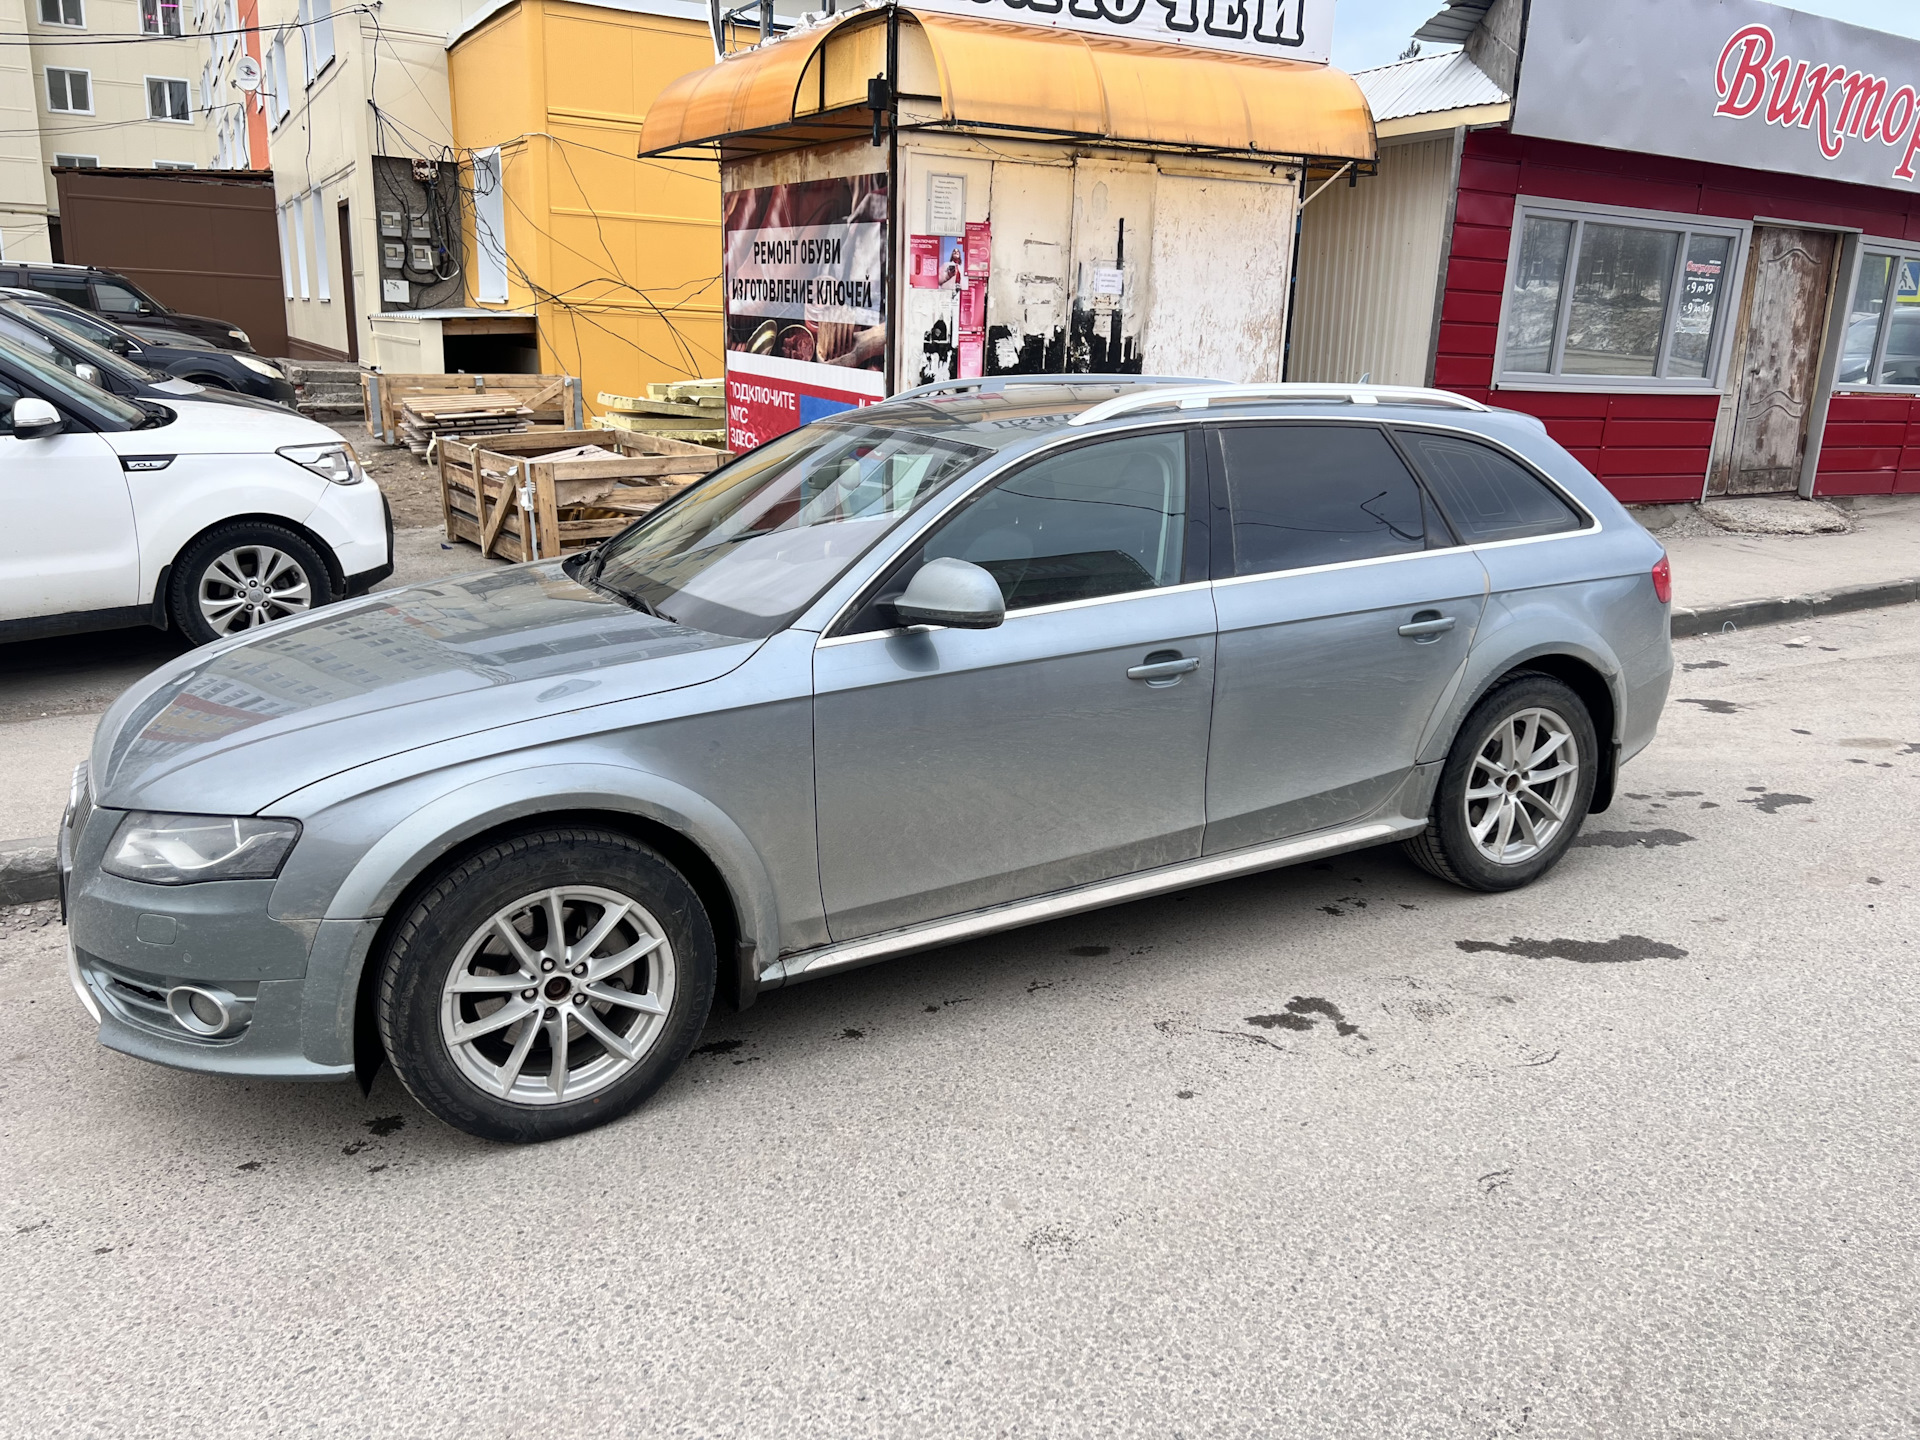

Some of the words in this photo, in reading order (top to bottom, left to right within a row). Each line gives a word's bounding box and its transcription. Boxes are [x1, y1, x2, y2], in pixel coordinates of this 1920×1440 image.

[754, 240, 798, 265] РЕМОНТ
[800, 238, 841, 265] ОБУВИ
[732, 278, 813, 305] ИЗГОТОВЛЕНИЕ
[816, 274, 873, 308] КЛЮЧЕЙ
[1691, 281, 1697, 294] 9
[1705, 282, 1713, 295] 19
[1687, 302, 1693, 314] 9
[1701, 302, 1710, 312] 16
[730, 381, 796, 411] ПОДКЛЮЧИТЕ
[730, 427, 760, 449] ЗДЕСЬ
